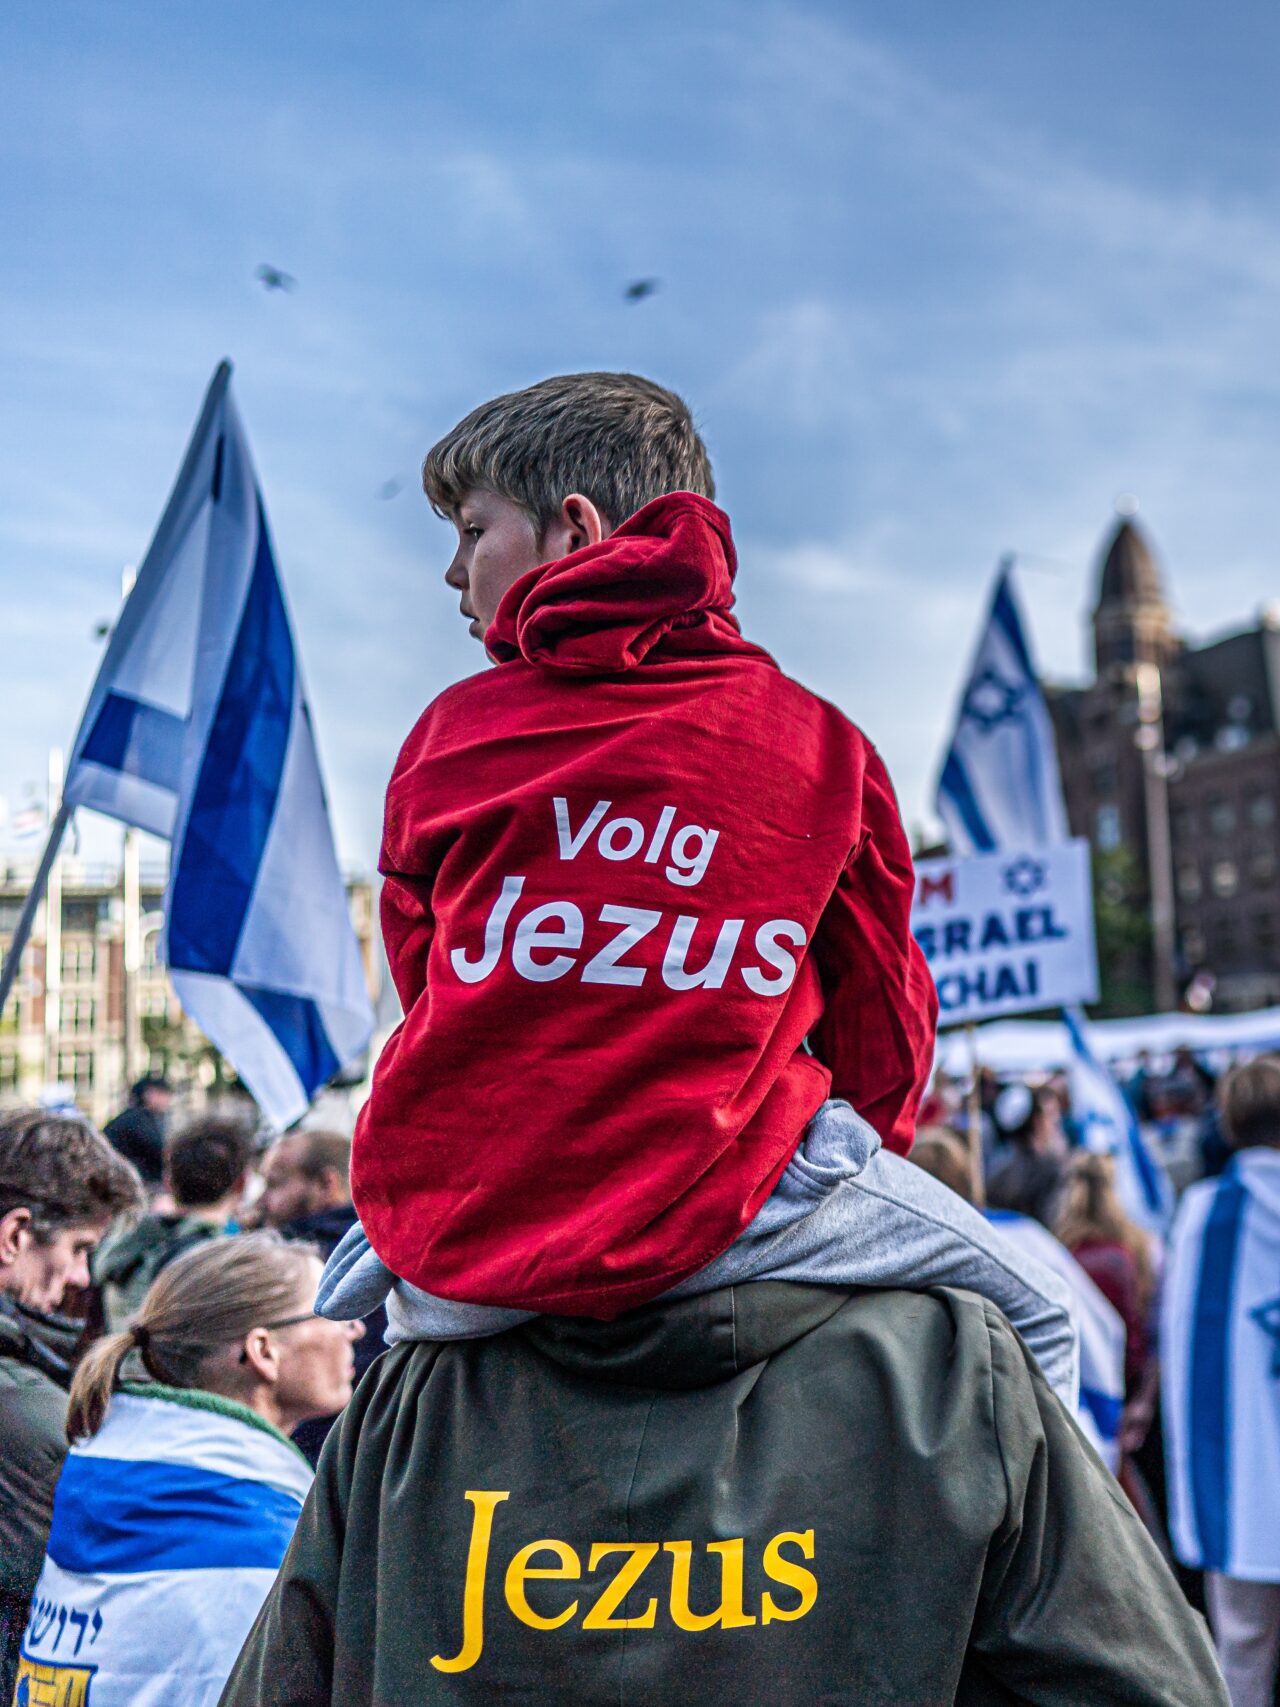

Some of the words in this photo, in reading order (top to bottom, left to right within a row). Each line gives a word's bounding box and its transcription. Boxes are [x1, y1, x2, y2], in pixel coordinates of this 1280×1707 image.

[553, 797, 719, 887] Volg
[451, 876, 807, 997] Jezus
[914, 906, 1068, 960] SRAEL
[937, 958, 1038, 1010] CHAI
[430, 1490, 818, 1673] Jezus
[28, 1595, 103, 1658] ירוש
